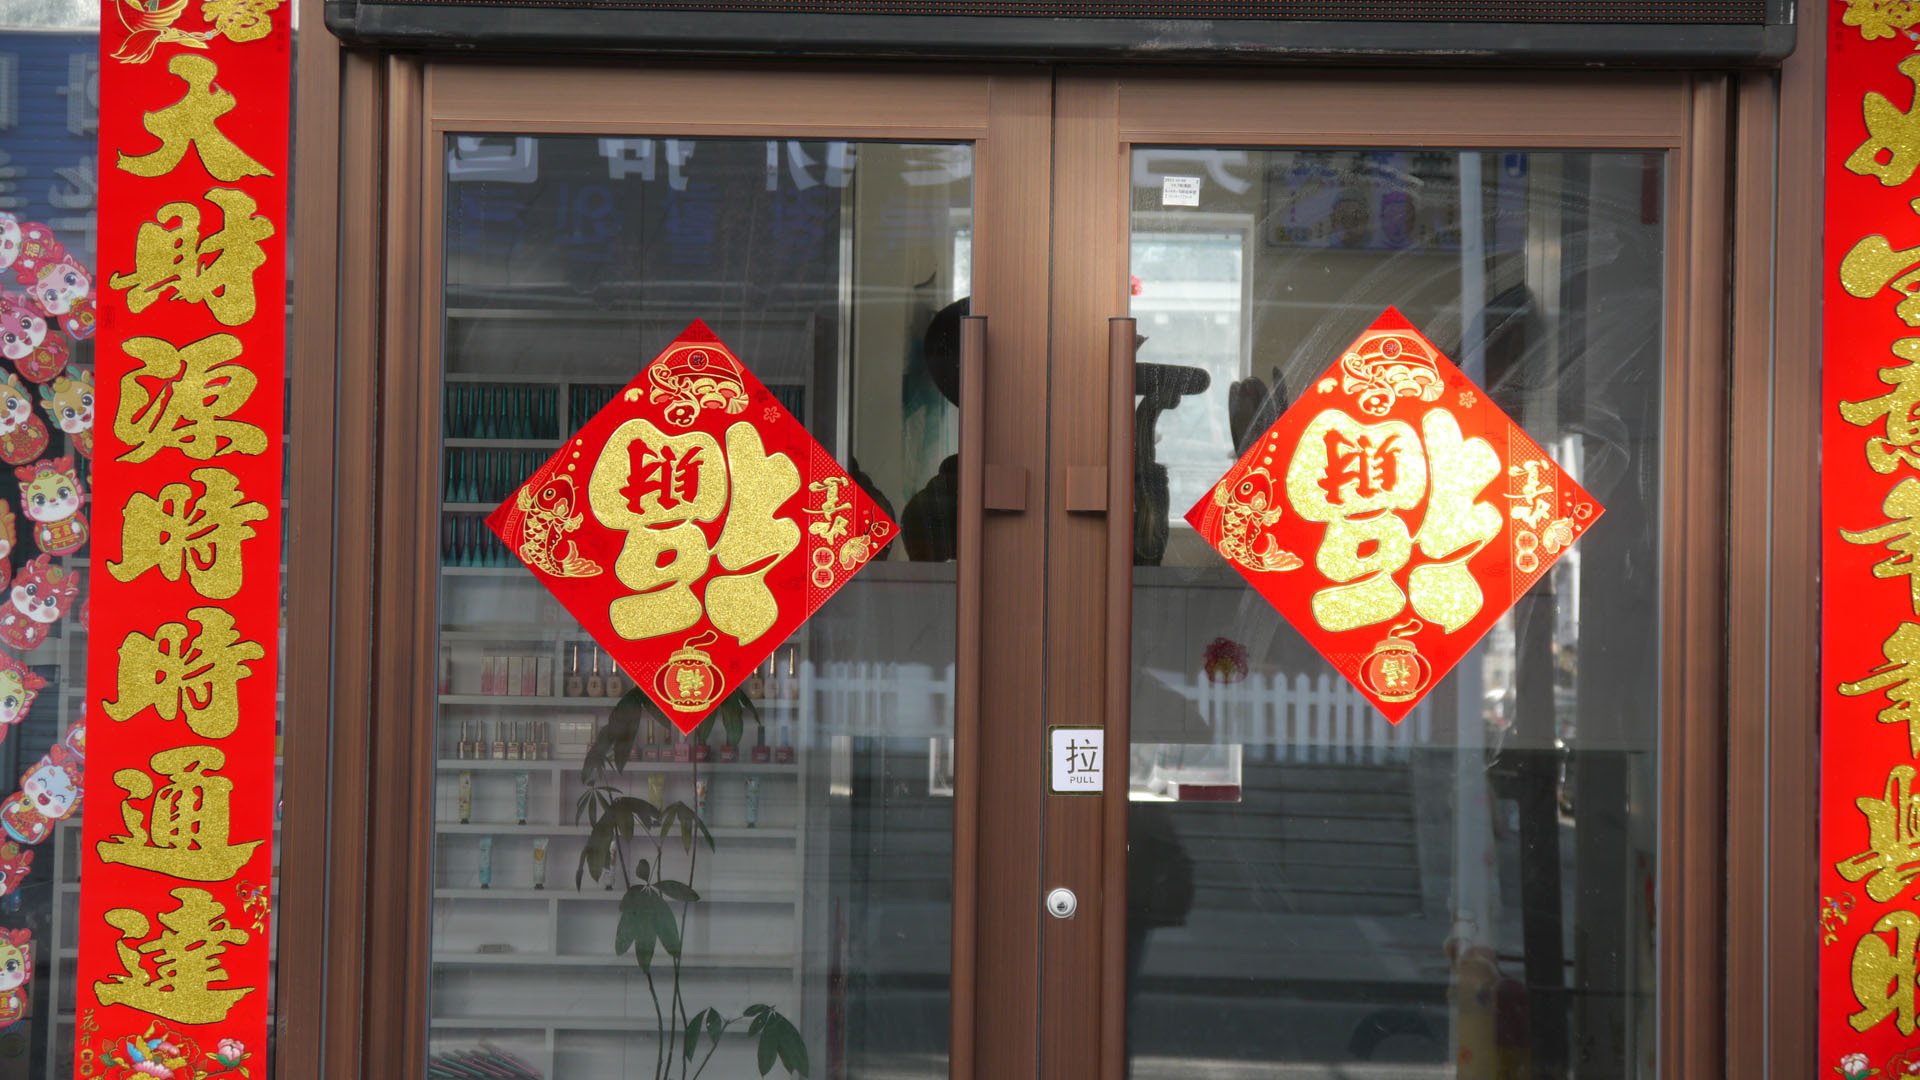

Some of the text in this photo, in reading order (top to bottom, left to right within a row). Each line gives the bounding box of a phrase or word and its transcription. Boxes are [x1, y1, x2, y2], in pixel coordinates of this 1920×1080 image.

[588, 418, 803, 647] 福
[1285, 407, 1504, 635] 福
[676, 668, 706, 698] 福
[1381, 655, 1411, 689] 福
[1065, 738, 1100, 775] 拉
[1070, 776, 1095, 784] PULL
